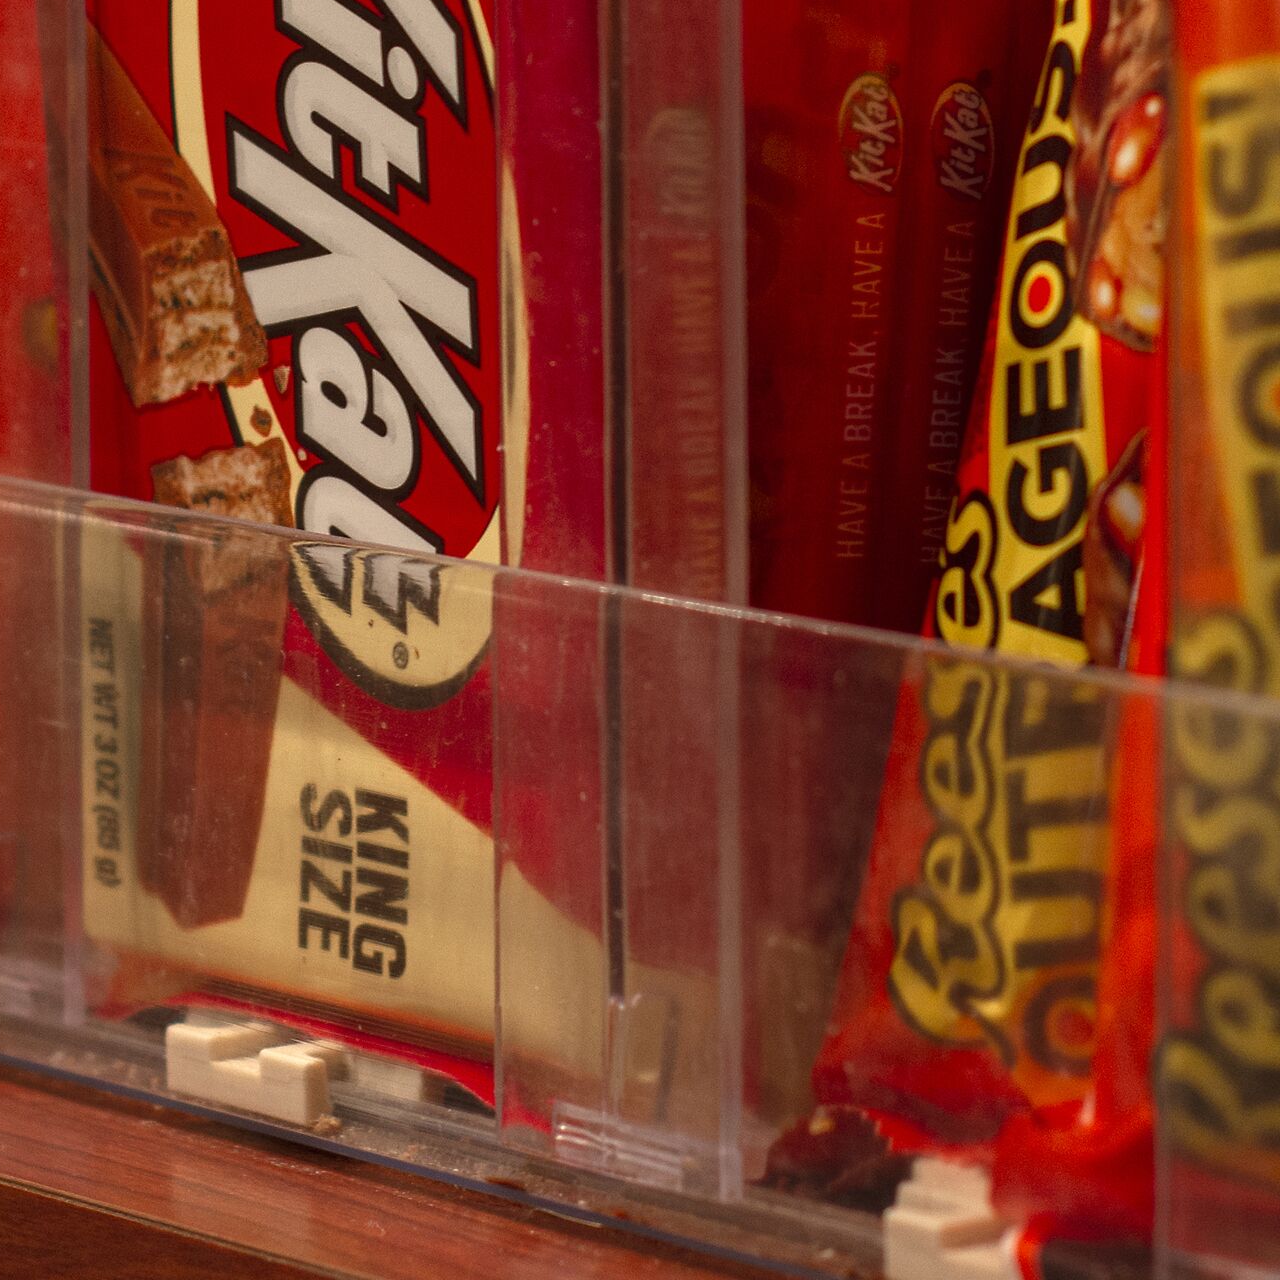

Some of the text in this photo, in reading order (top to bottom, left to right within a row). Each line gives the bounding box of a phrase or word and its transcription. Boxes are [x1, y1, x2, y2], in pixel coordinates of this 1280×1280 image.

[849, 78, 897, 192] KitKat
[939, 86, 987, 200] KitKat
[856, 211, 888, 229] A
[947, 219, 976, 237] A
[852, 239, 886, 320] HAVE
[939, 241, 974, 326] HAVE
[841, 451, 871, 470] A
[927, 458, 957, 474] A
[837, 480, 869, 560] HAVE
[920, 485, 952, 563] HAVE
[88, 616, 114, 673] NET
[92, 683, 118, 730] WT
[93, 733, 117, 755] 3
[94, 758, 120, 800] OZ
[890, 492, 1014, 1050] Reese's
[298, 783, 353, 961] SIZE
[352, 787, 410, 980] KING
